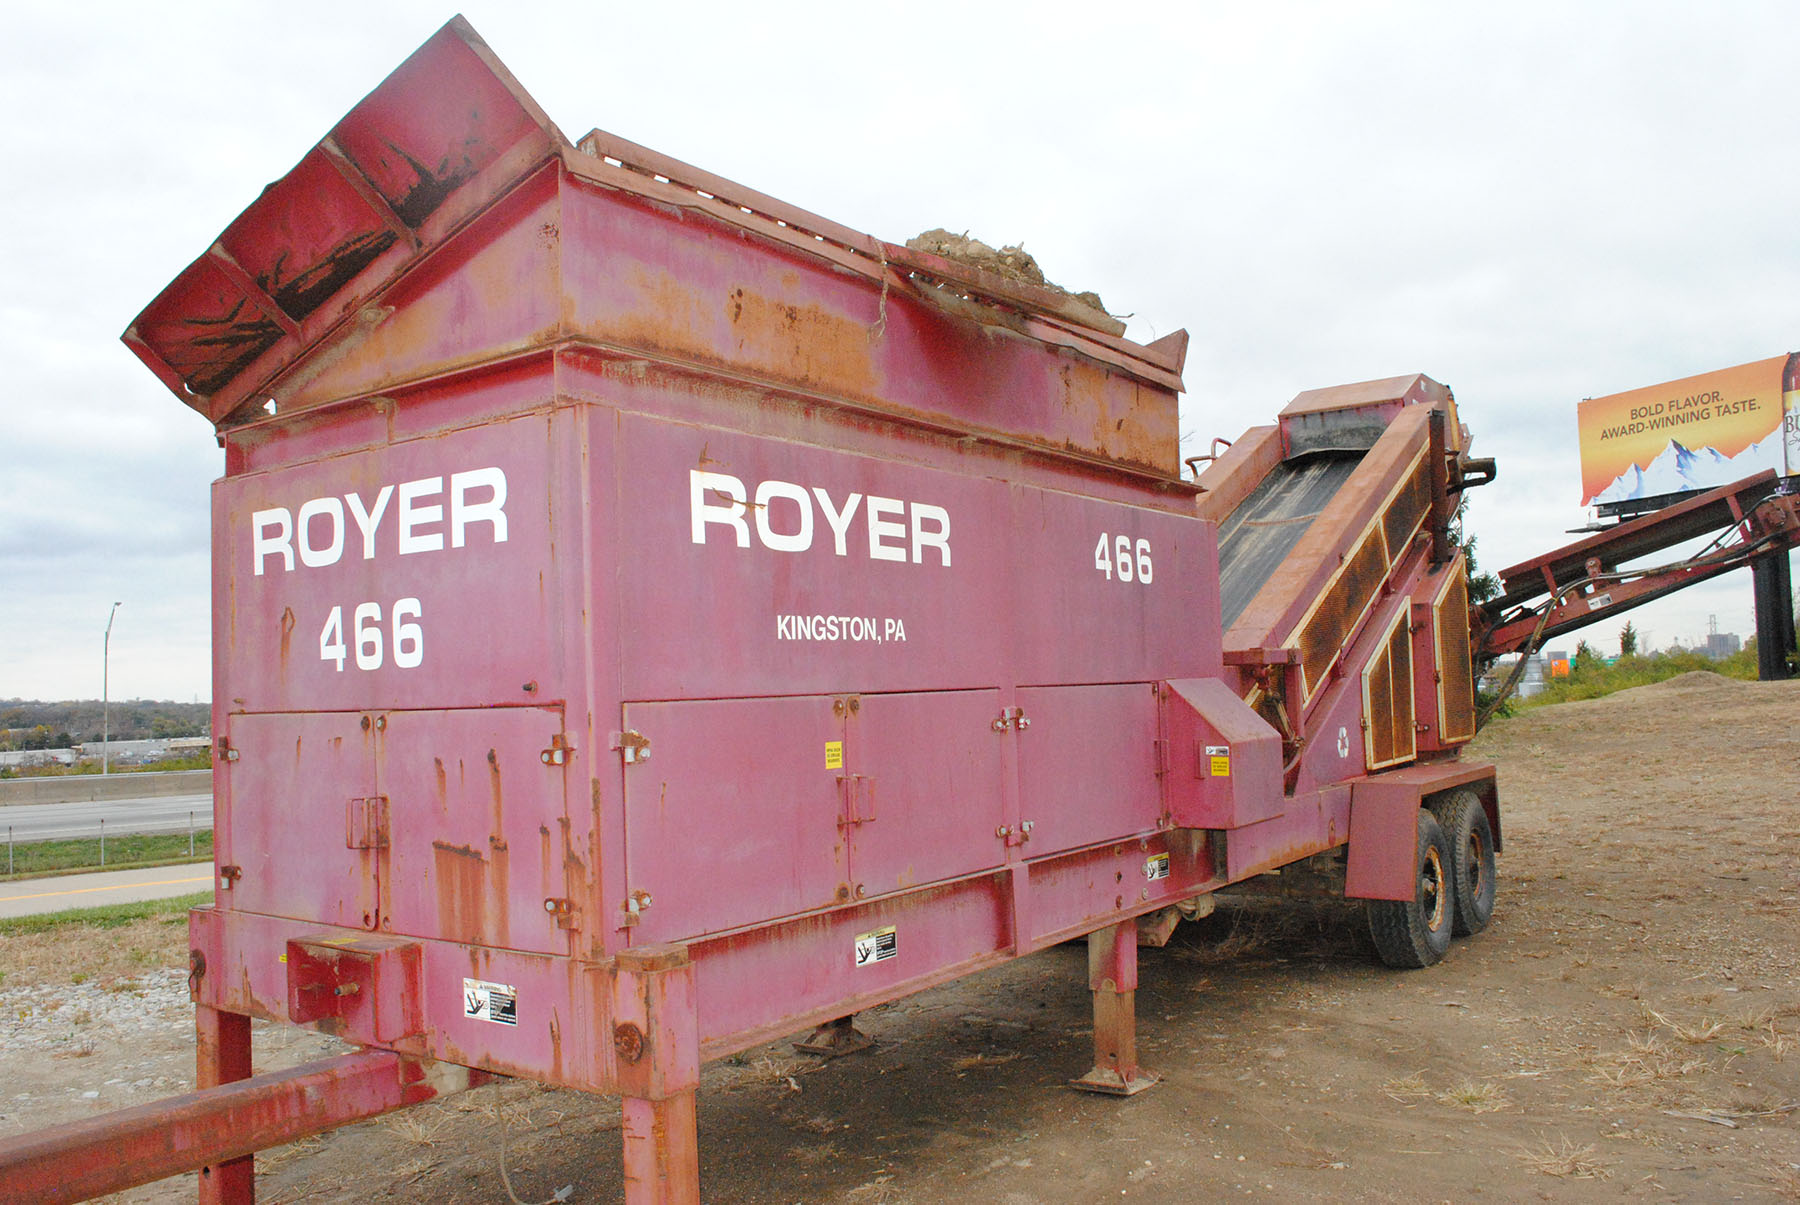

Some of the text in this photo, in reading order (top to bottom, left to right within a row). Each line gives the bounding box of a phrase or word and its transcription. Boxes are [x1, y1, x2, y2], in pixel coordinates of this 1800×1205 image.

[1600, 398, 1761, 440] AWARD-WINNING TASTE.
[1630, 391, 1724, 420] BOLD FLAVOR.
[252, 467, 508, 576] ROYER
[689, 469, 952, 567] ROYER
[1094, 532, 1153, 585] 466
[320, 597, 423, 672] 466
[777, 615, 906, 644] KINGSTON, PA
